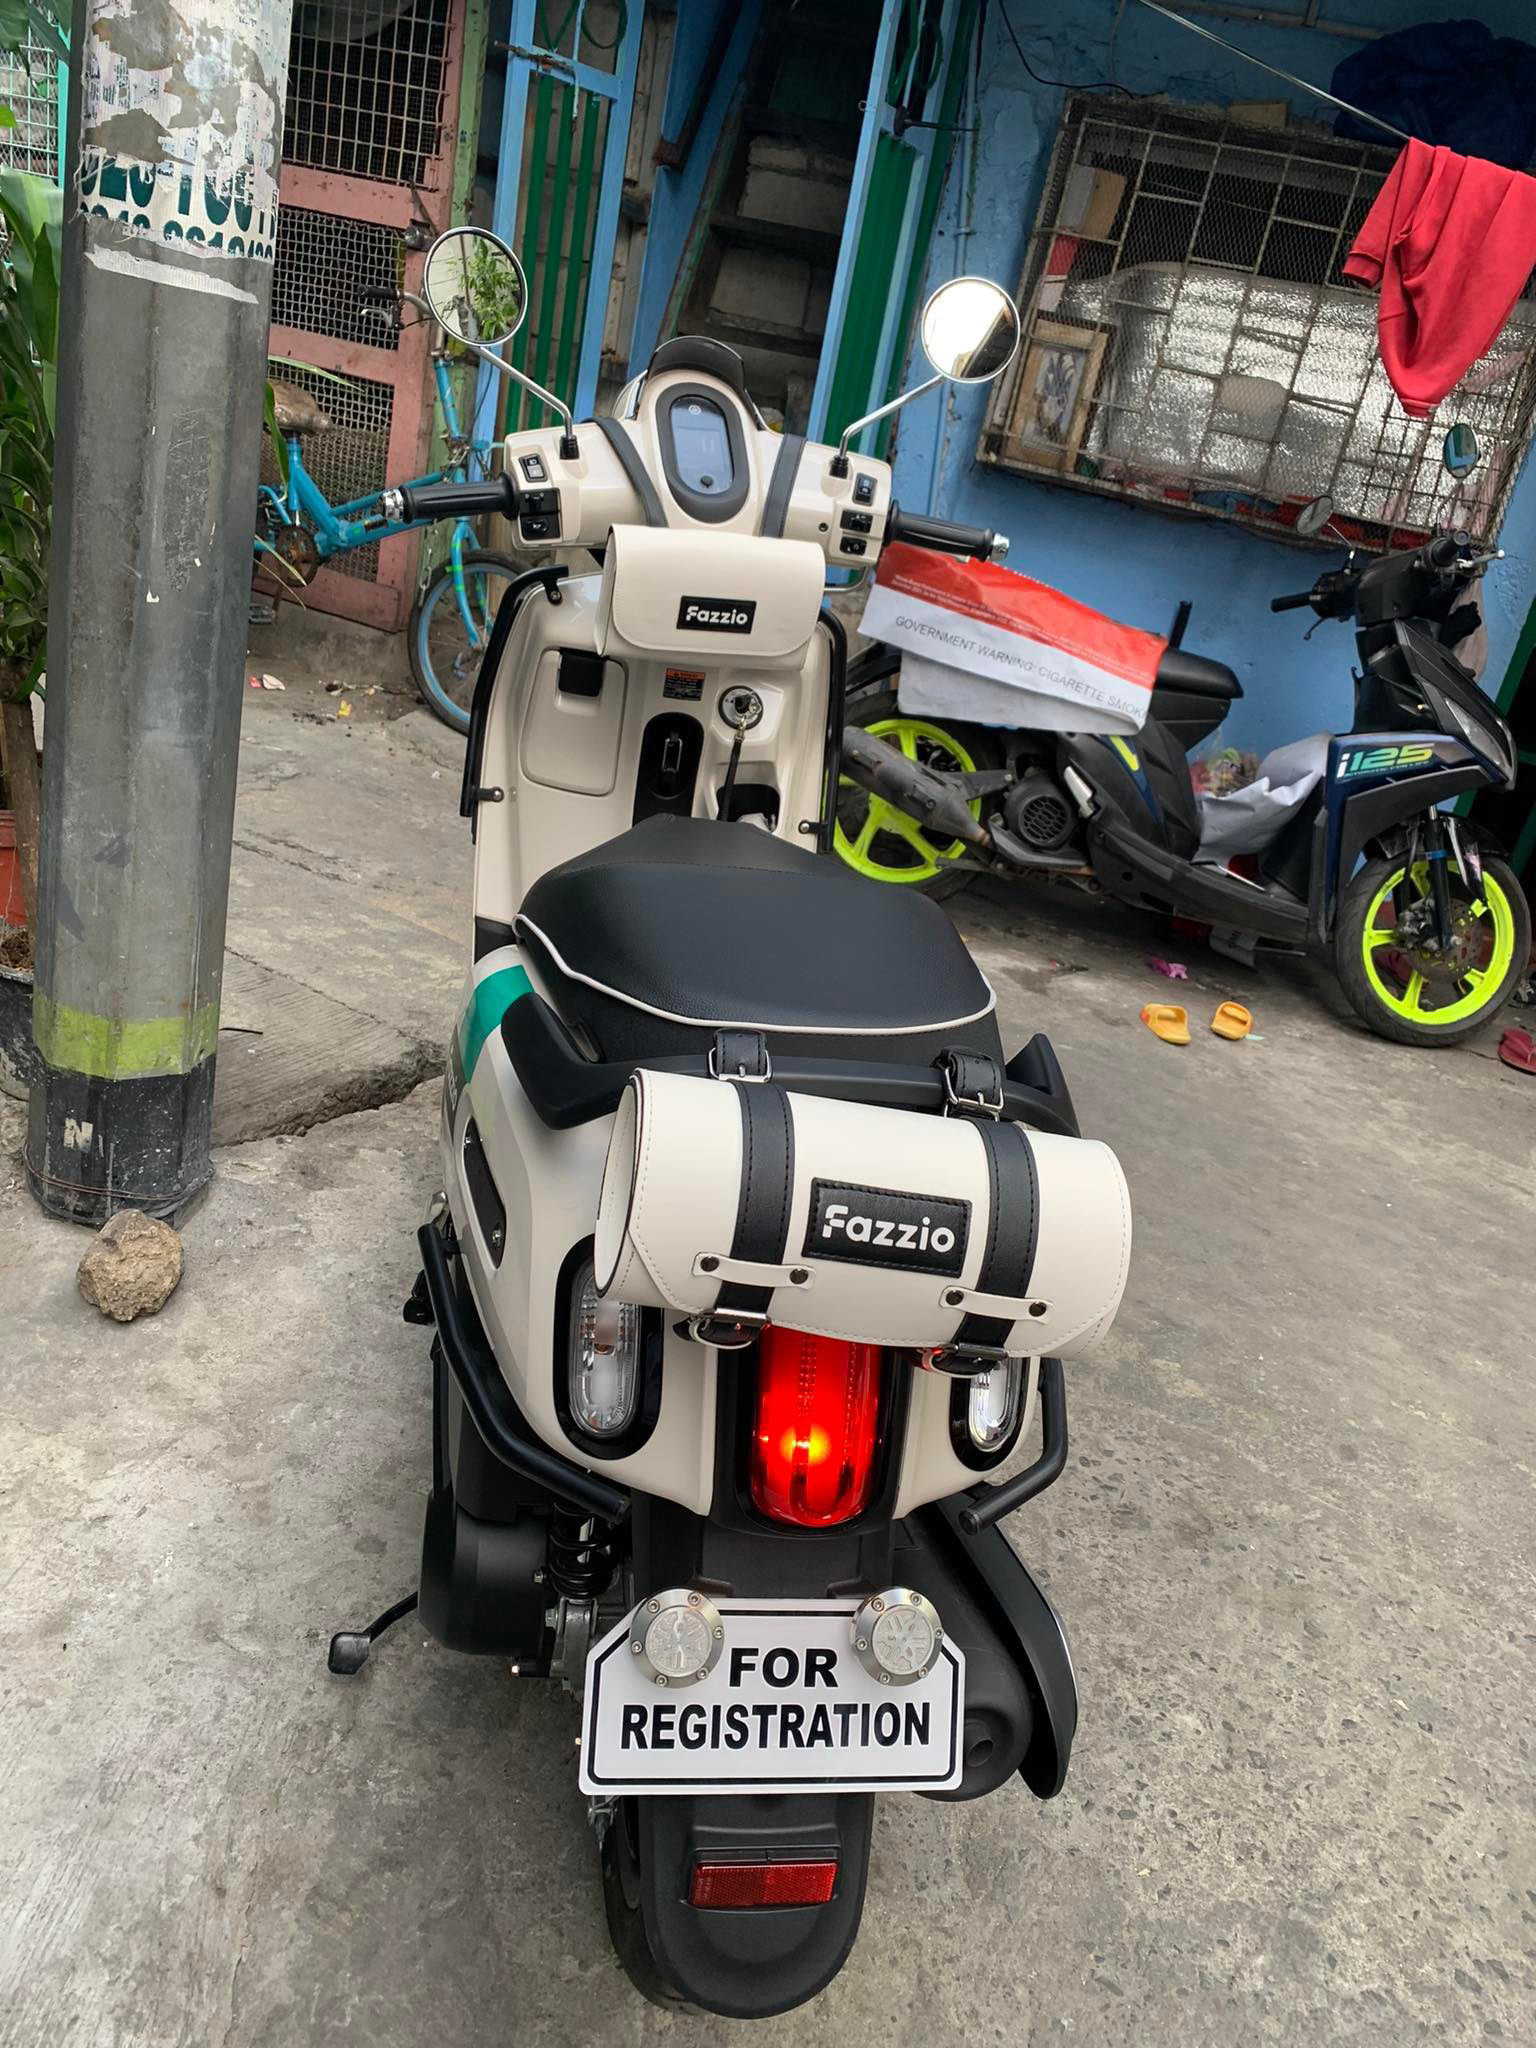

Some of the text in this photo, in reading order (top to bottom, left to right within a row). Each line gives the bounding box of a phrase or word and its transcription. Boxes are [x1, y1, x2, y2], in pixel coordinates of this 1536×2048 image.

[685, 605, 748, 625] Fazzio
[895, 615, 977, 651] GOVERNMENT
[1038, 665, 1105, 703] CIGARETTE
[1337, 743, 1435, 778] i125
[821, 1204, 956, 1253] Fazzio
[728, 1647, 839, 1688] FOR
[620, 1702, 931, 1750] REGISTRATION
